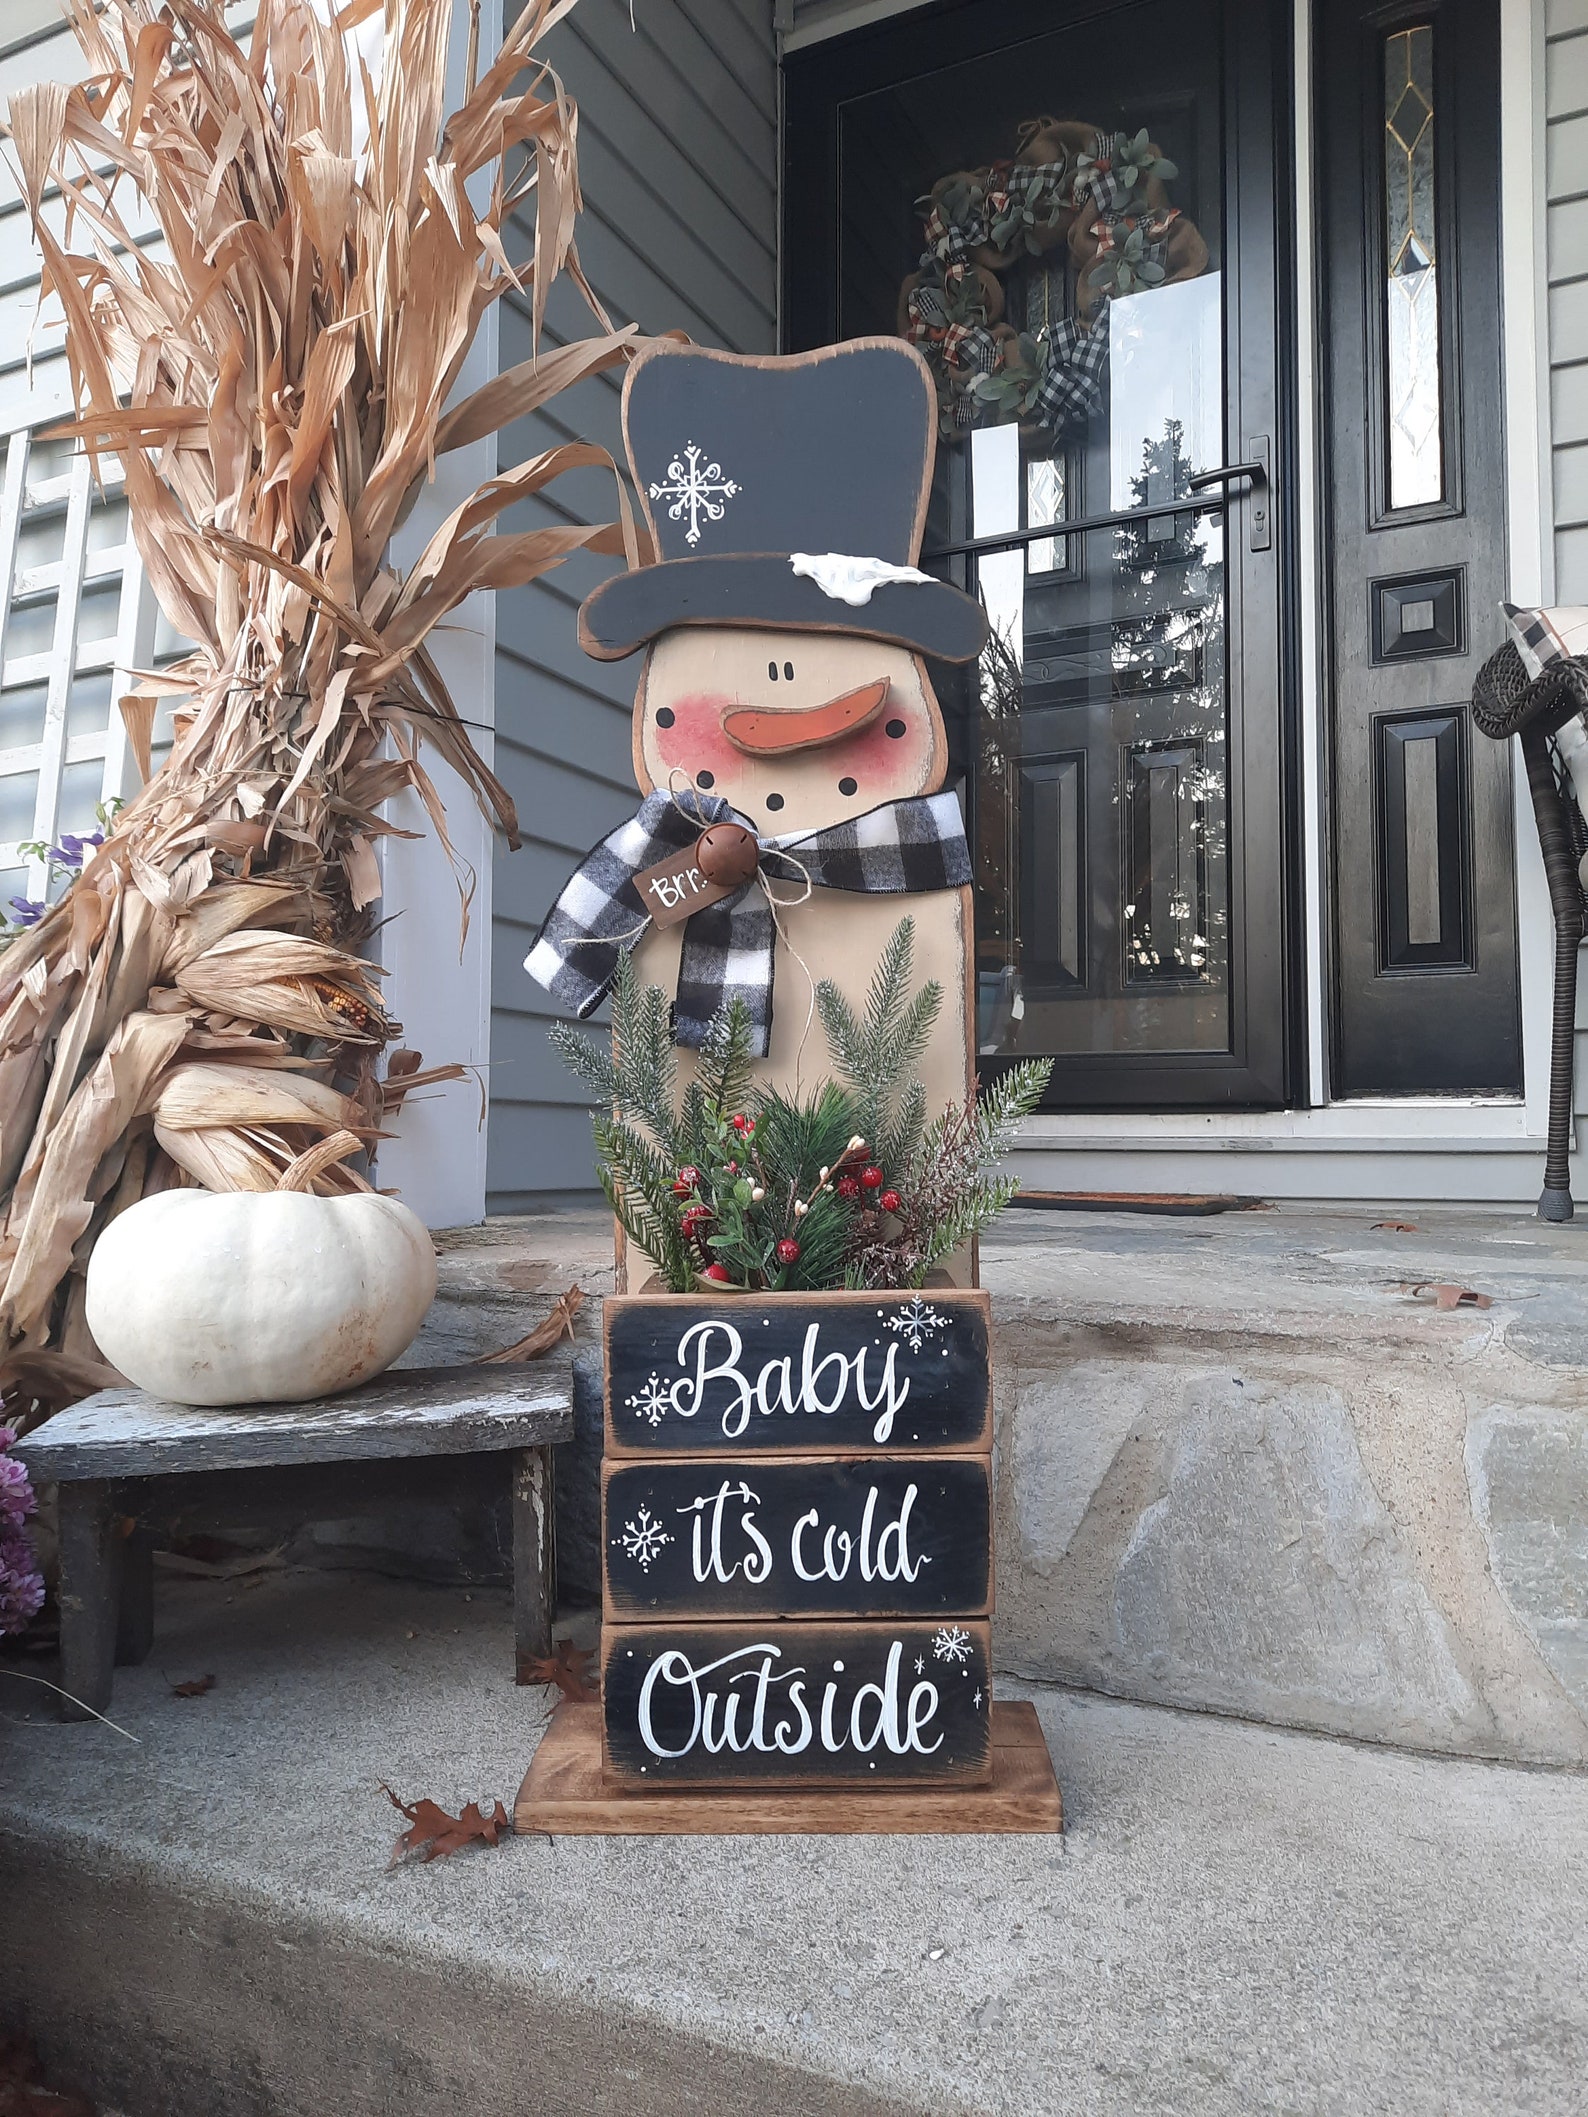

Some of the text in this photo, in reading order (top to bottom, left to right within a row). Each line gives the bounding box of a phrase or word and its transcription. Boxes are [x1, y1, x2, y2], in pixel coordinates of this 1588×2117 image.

[669, 1320, 911, 1443] Baby
[791, 1483, 932, 1583] cold
[637, 1640, 945, 1758] Outside
